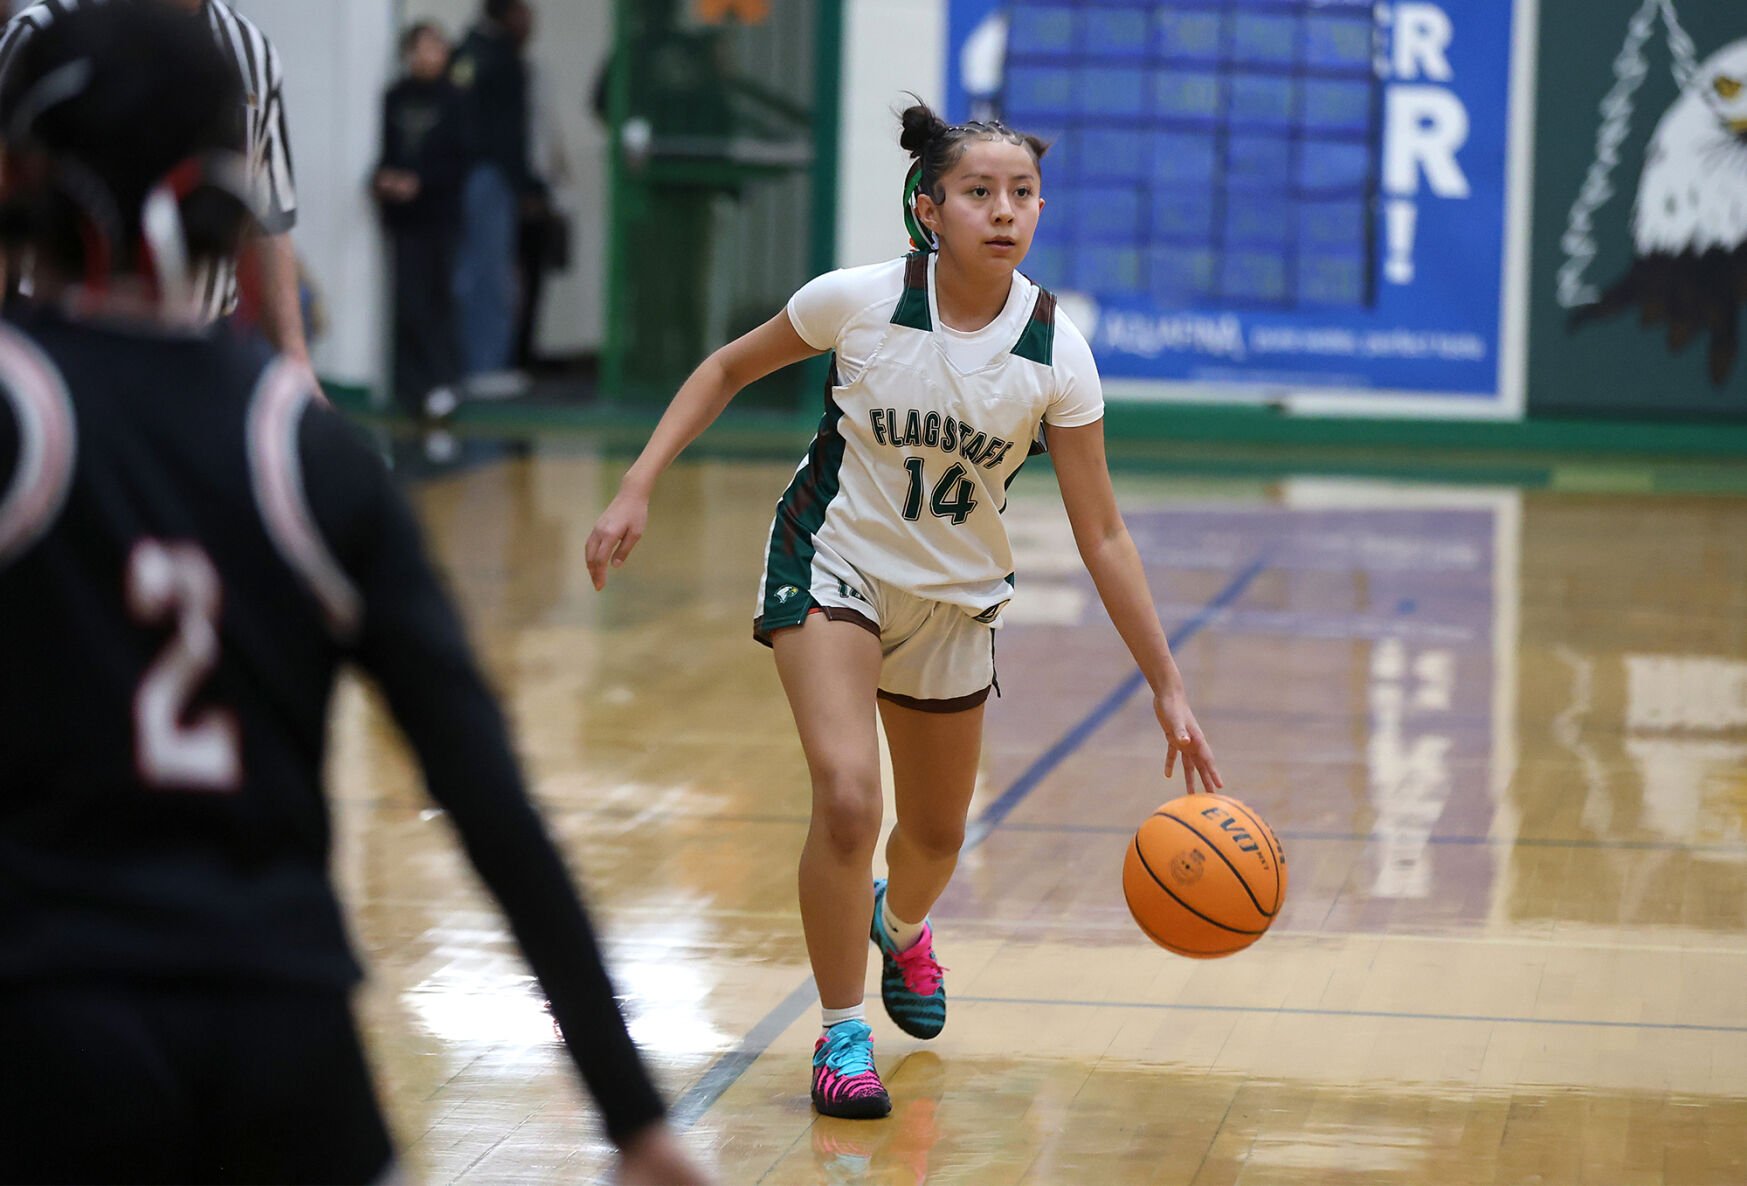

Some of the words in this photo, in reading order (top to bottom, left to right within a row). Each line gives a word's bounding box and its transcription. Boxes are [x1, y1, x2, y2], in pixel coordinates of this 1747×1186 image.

[902, 456, 978, 525] 14
[128, 539, 242, 789] 2
[1201, 807, 1259, 852] EVO
